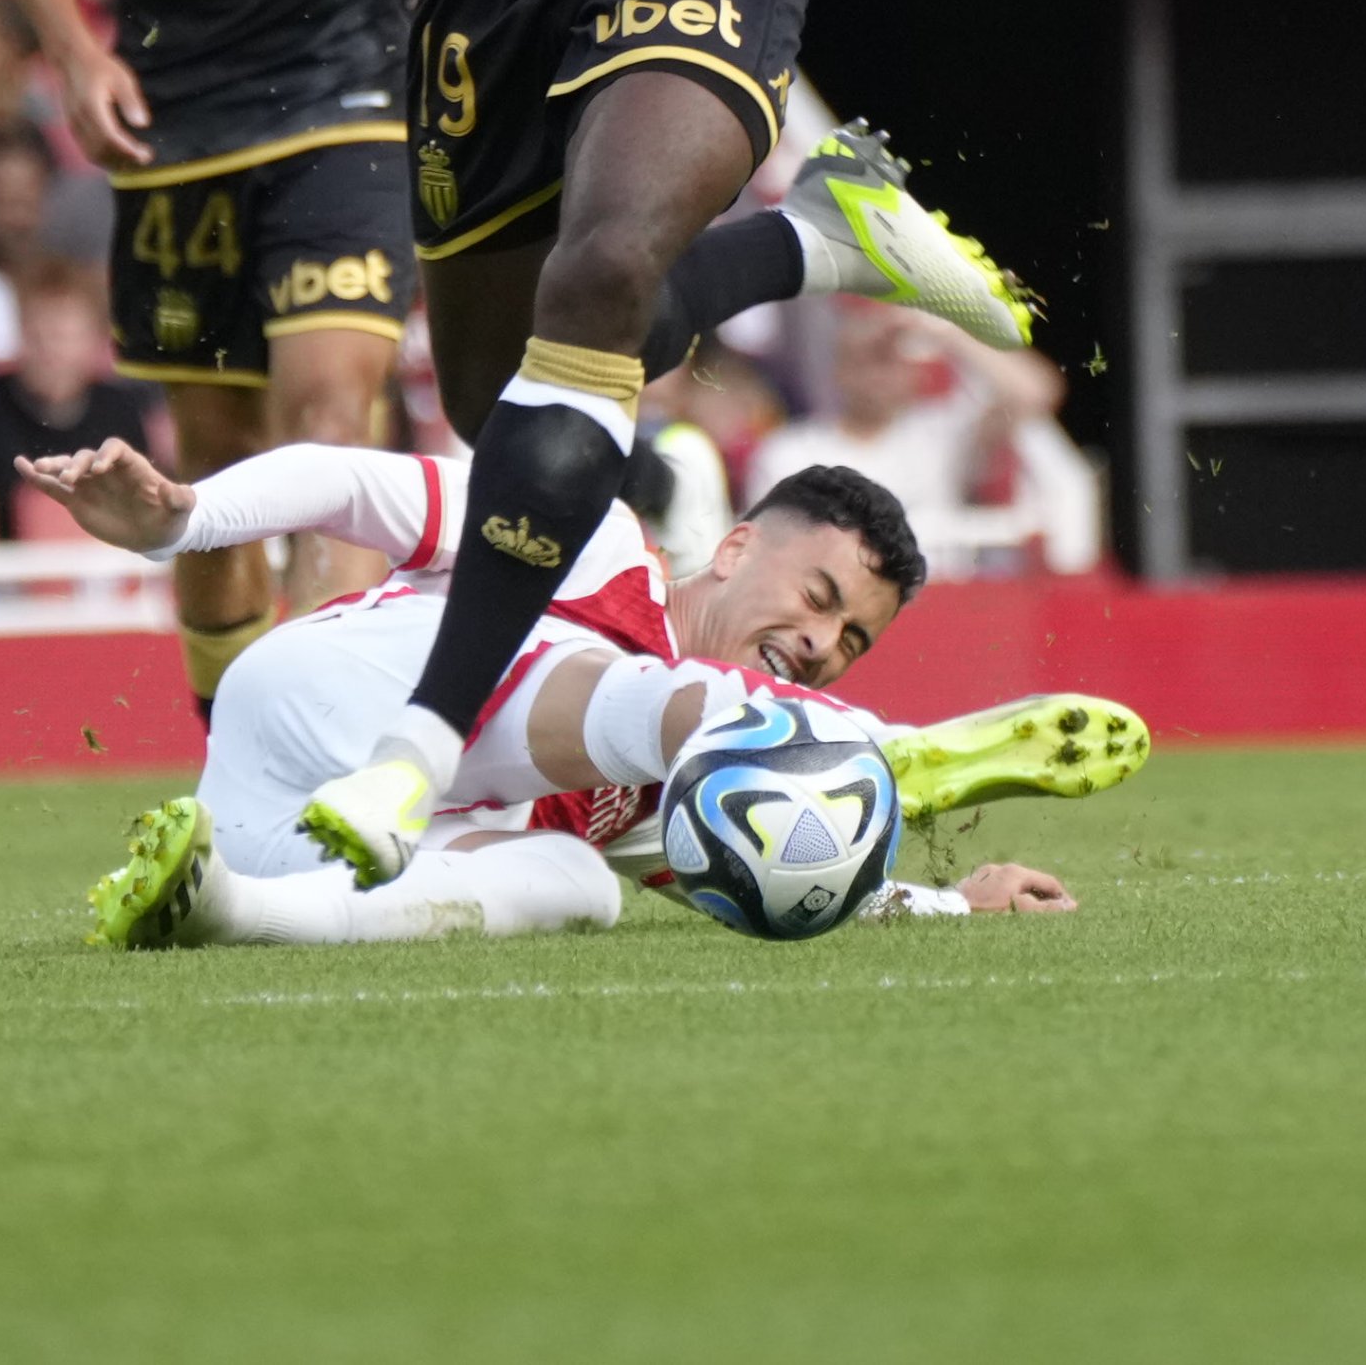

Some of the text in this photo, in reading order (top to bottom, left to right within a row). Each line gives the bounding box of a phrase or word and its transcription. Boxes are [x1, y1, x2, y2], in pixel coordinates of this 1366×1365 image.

[419, 21, 477, 137] 19
[133, 190, 242, 278] 44
[268, 248, 392, 314] vbet
